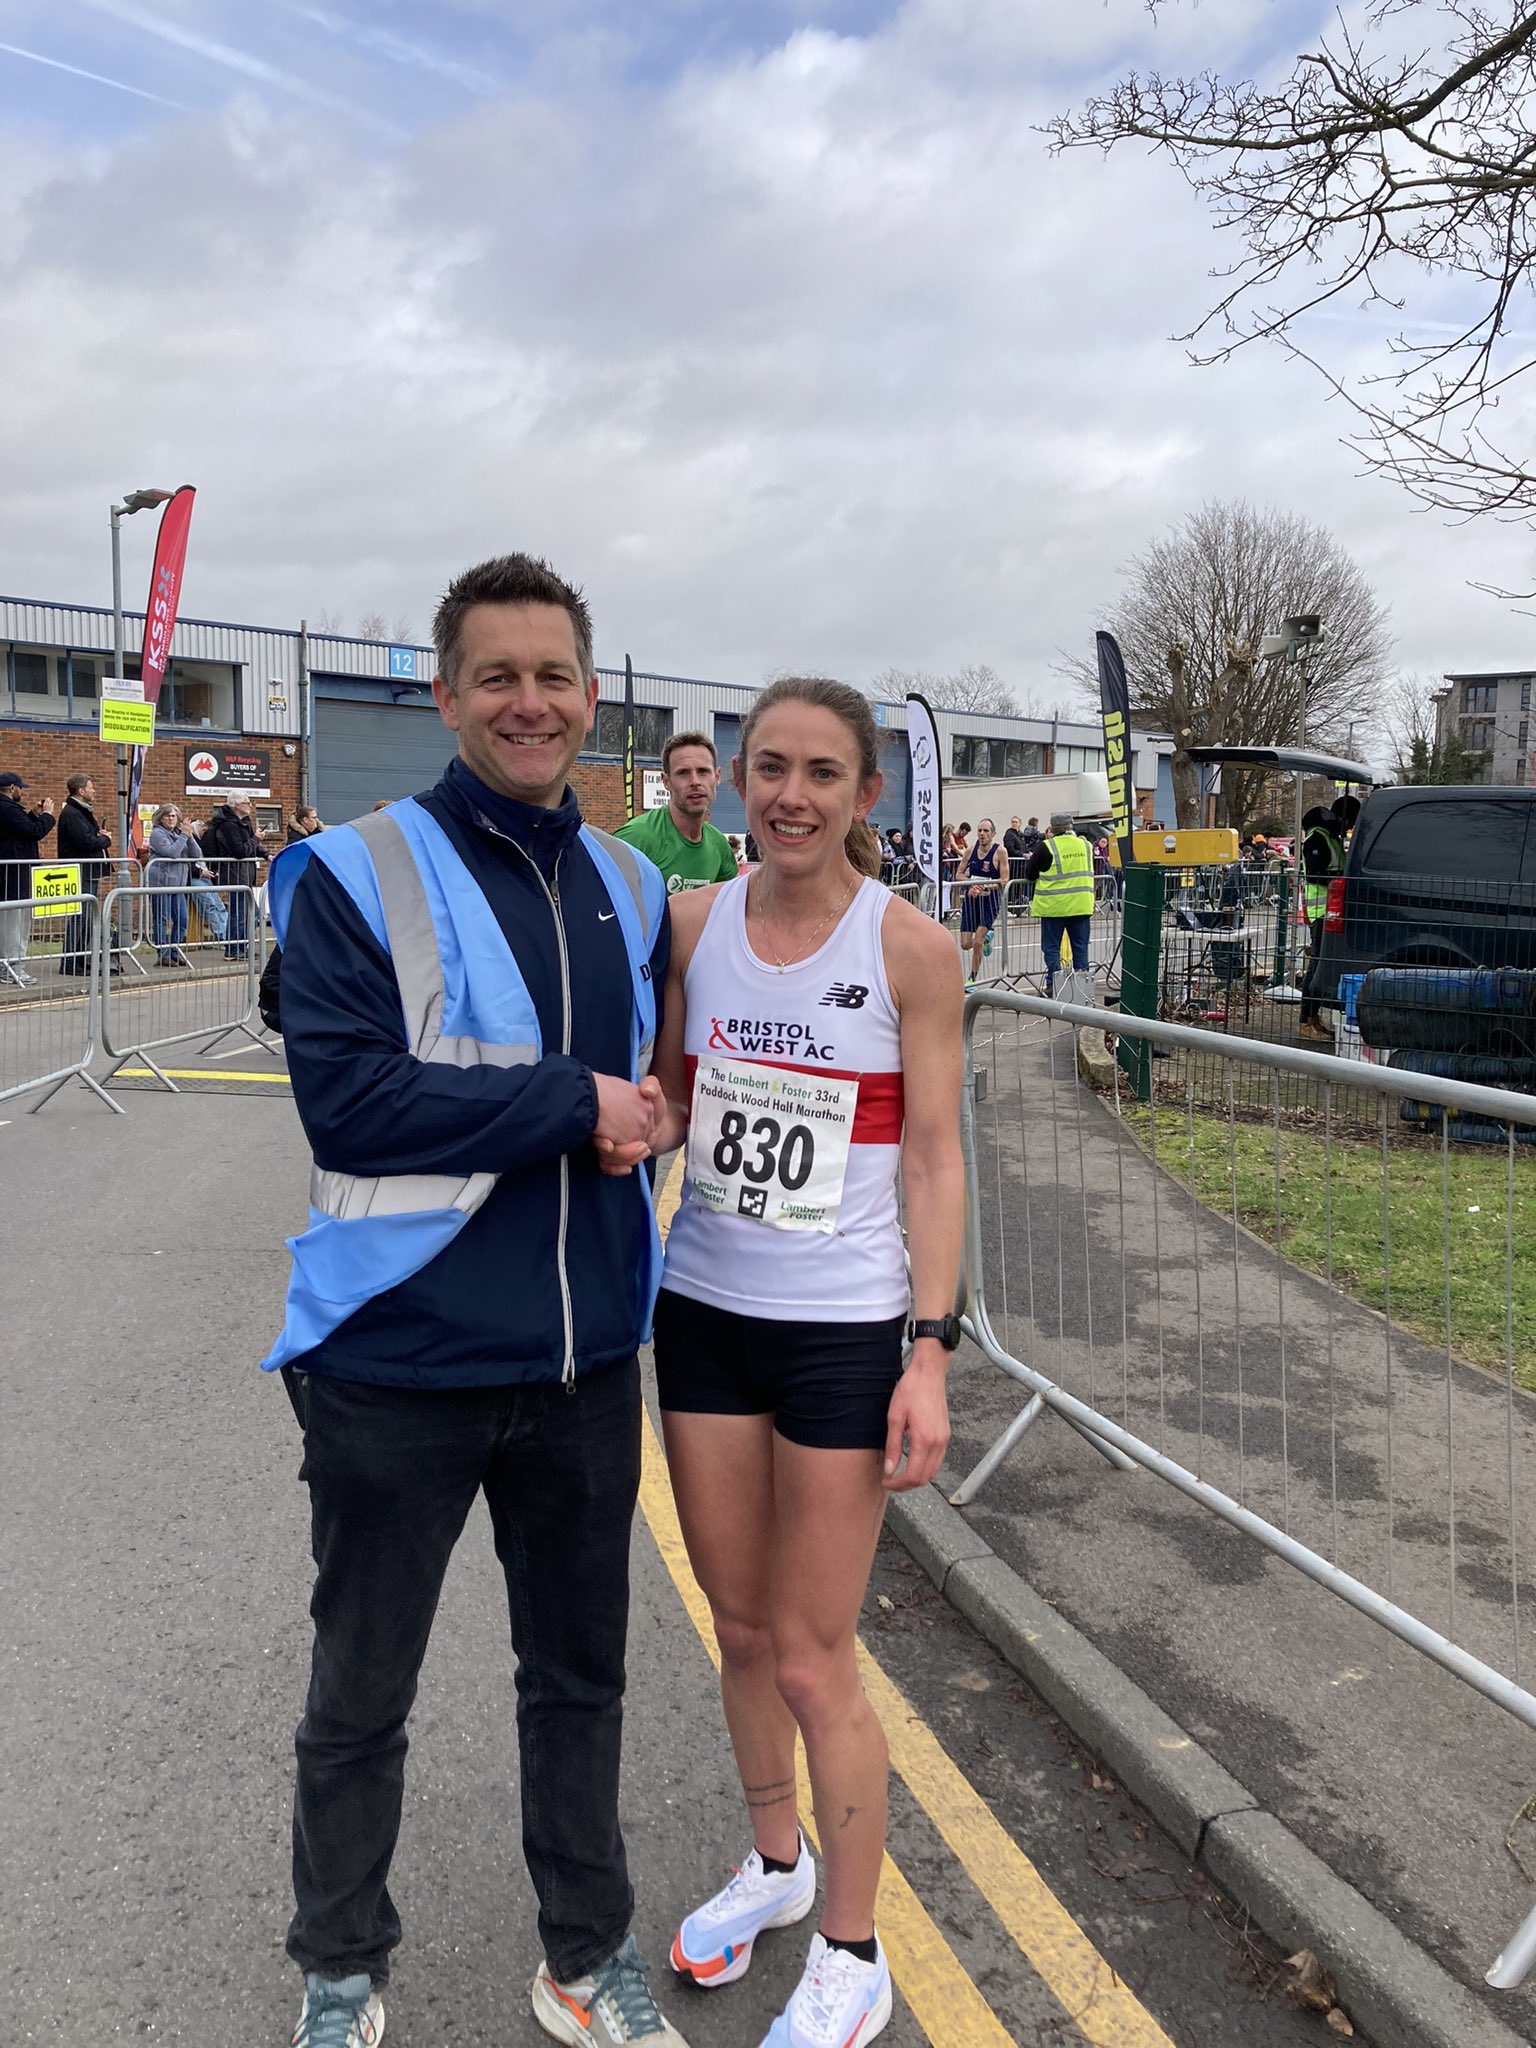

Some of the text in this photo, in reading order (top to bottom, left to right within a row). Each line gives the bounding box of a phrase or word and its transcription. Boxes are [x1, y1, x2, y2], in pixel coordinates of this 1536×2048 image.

[148, 596, 168, 670] KSS
[393, 653, 412, 672] 12
[104, 722, 150, 733] DISQUALIFICATION
[36, 883, 77, 898] RACE HO
[727, 1019, 815, 1041] BRISTOL
[740, 1037, 799, 1056] WEST
[804, 1043, 835, 1060] AC
[711, 1068, 841, 1104] The Lambert & Foster 33rd
[700, 1083, 846, 1123] Paddock Wood Half Marathon
[713, 1110, 815, 1191] 830
[693, 1177, 727, 1196] Lambert
[780, 1201, 826, 1214] Lambert
